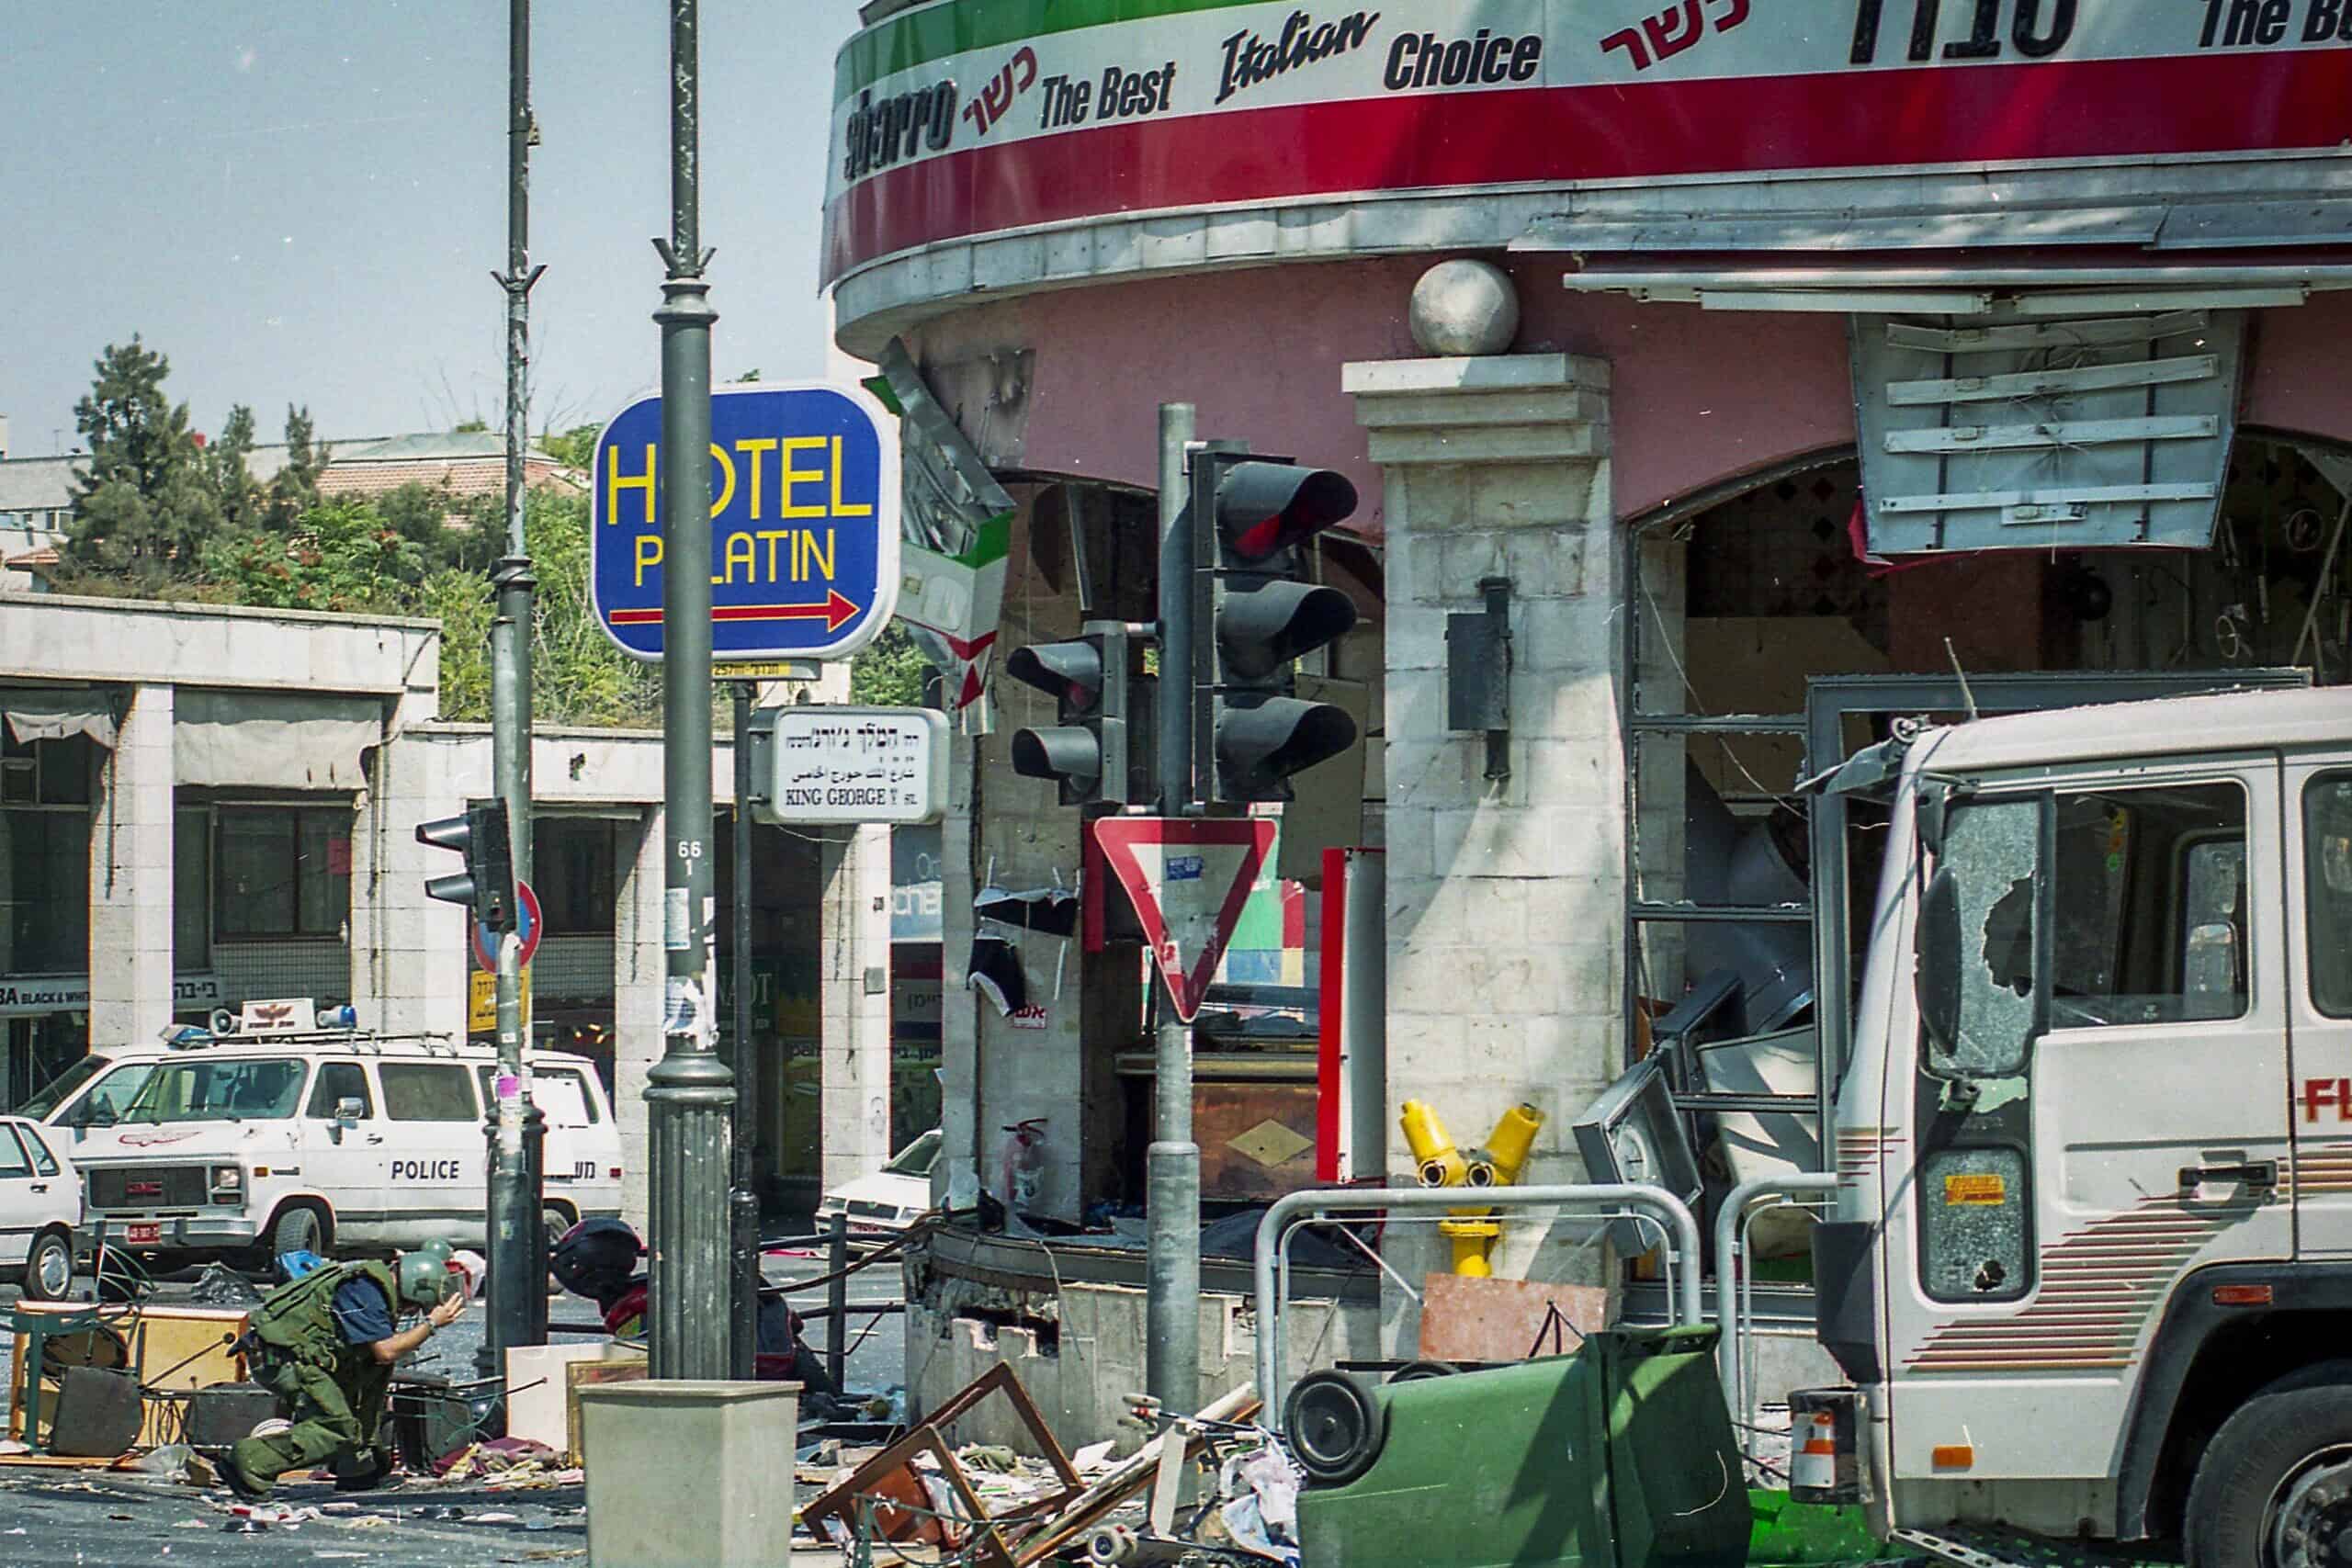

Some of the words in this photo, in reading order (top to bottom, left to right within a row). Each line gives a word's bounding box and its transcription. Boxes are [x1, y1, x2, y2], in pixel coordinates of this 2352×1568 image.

[2199, 0, 2291, 47] The
[963, 46, 1037, 136] כשר
[1039, 74, 1091, 130] The
[1097, 62, 1176, 120] Best
[1215, 9, 1381, 105] Italian
[1384, 28, 1542, 90] Choice
[634, 528, 835, 586] PATIN
[786, 787, 823, 806] KING
[827, 787, 886, 806] GEORGE
[678, 840, 701, 857] 66
[391, 1160, 459, 1179] POLICE
